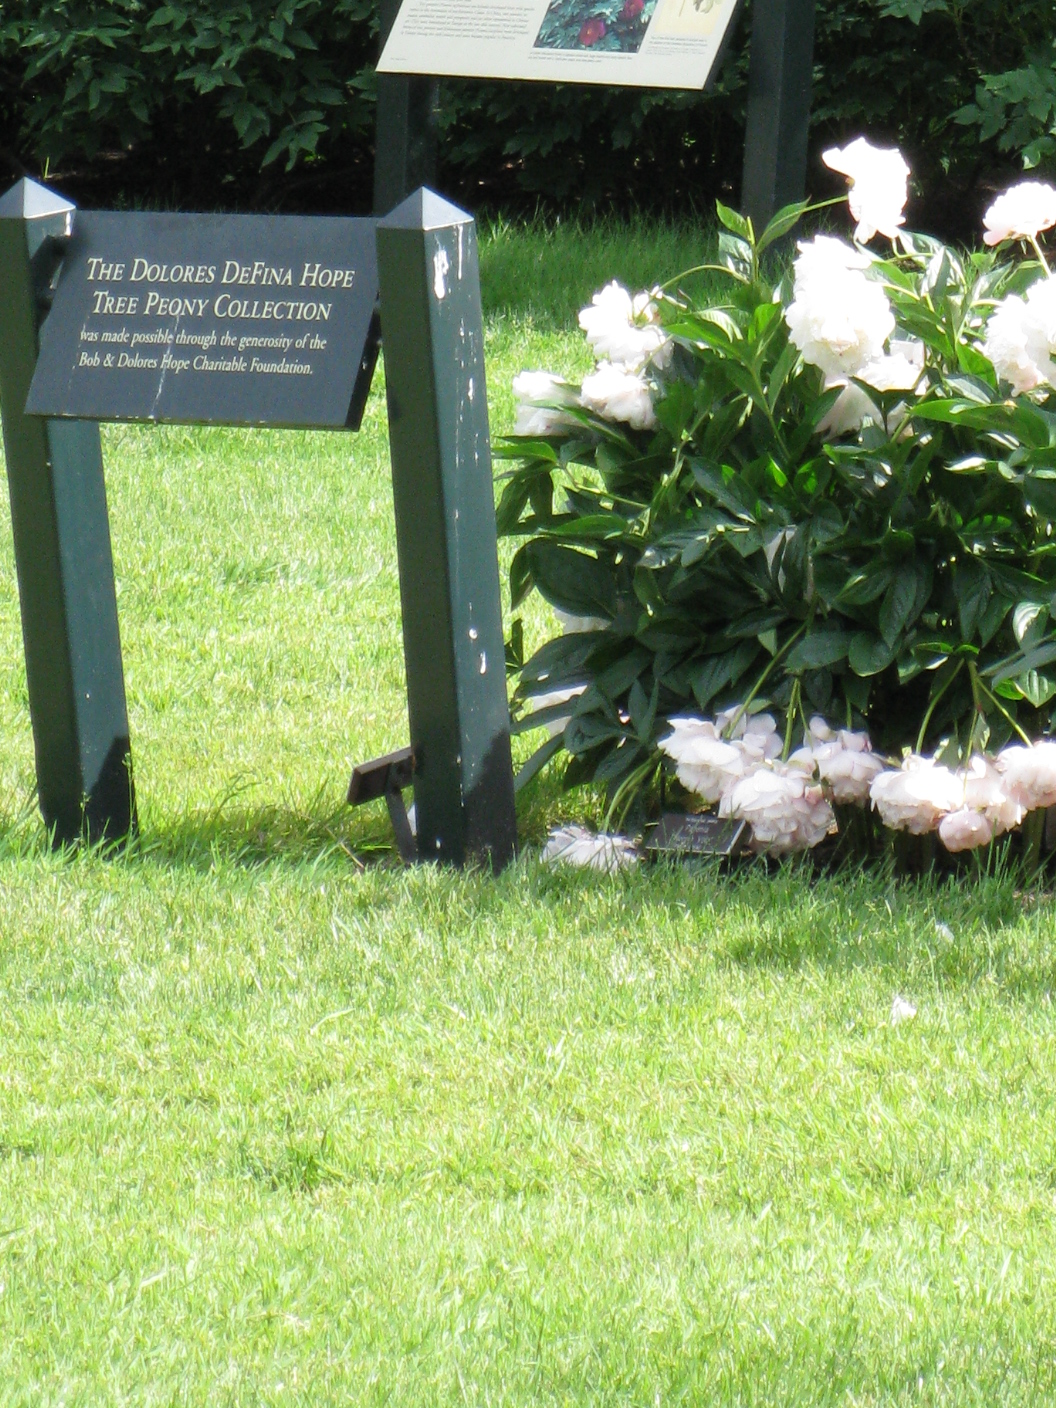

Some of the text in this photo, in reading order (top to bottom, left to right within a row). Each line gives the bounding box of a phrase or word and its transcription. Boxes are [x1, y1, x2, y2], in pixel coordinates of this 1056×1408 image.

[80, 329, 327, 350] was made possible through the generosity of the
[79, 352, 313, 375] Bob & Dolores Hope Charitable Foundation.
